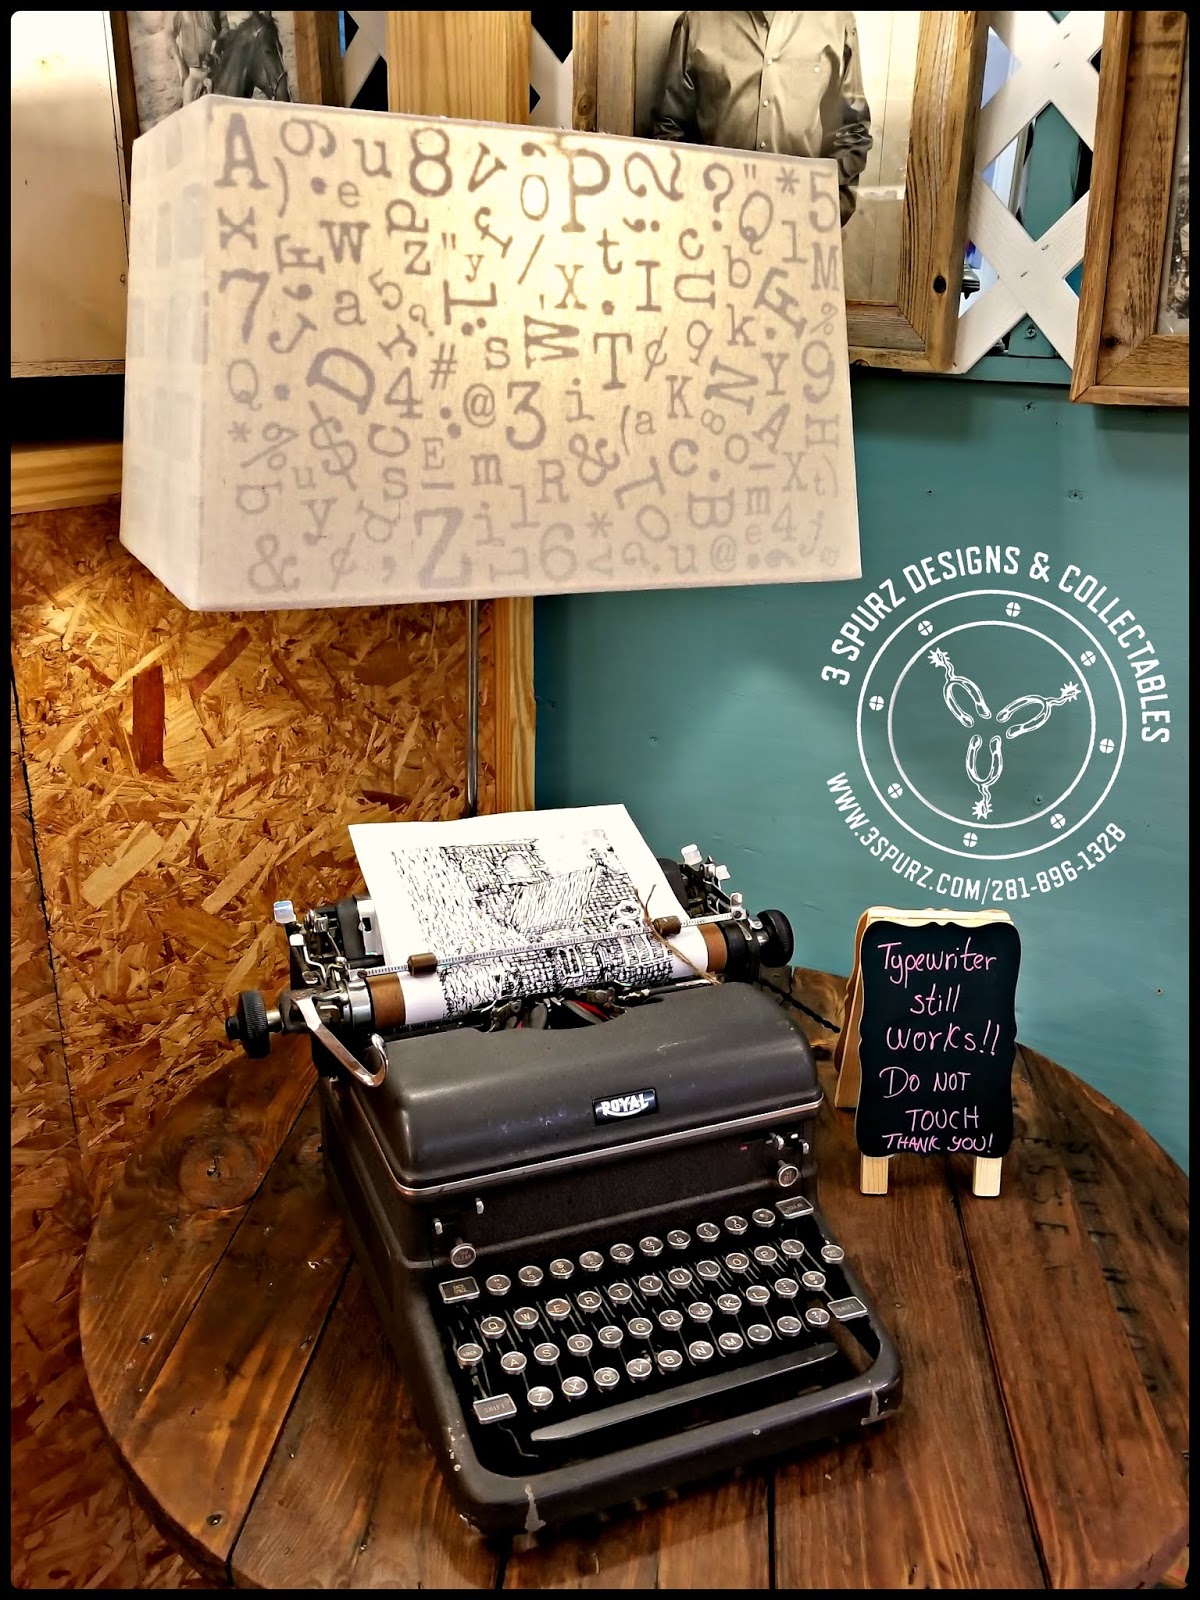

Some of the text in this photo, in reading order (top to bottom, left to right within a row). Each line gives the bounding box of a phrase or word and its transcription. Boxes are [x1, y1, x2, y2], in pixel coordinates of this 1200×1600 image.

[214, 112, 270, 191] A
[408, 126, 451, 199] 8
[337, 180, 361, 209] e
[560, 149, 611, 233] P
[809, 170, 837, 233] 5
[737, 189, 774, 256] Q
[596, 228, 623, 275] t
[722, 244, 752, 289] b
[810, 241, 839, 291] M
[218, 267, 272, 344] 7
[333, 288, 367, 327] a
[725, 303, 756, 347] k
[305, 346, 376, 415] D
[592, 331, 634, 391] T
[760, 351, 790, 396] Y
[802, 338, 836, 403] 9
[227, 358, 262, 411] Q
[384, 366, 423, 419] 4
[563, 377, 597, 423] i
[665, 374, 694, 420] K
[505, 379, 548, 450] 3
[634, 410, 656, 436] a
[752, 403, 790, 453] A
[422, 436, 445, 470] E
[470, 452, 504, 486] m
[536, 458, 570, 503] R
[473, 500, 505, 547] i
[772, 501, 797, 542] 4
[414, 507, 472, 588] Z
[540, 521, 578, 583] 6
[877, 936, 997, 989] Typewriter
[909, 983, 961, 1017] still
[601, 1093, 649, 1116] ROYAL
[933, 1071, 971, 1093] NOT
[905, 1105, 980, 1132] TOUCH
[881, 1132, 941, 1153] THANK
[674, 1273, 685, 1281] U
[584, 1297, 595, 1305] R
[665, 1315, 676, 1323] H
[488, 1321, 499, 1330] Q
[575, 1340, 585, 1348] D
[635, 1323, 646, 1331] G
[724, 1338, 737, 1346] M
[541, 1349, 552, 1358] S
[664, 1355, 675, 1364] B
[696, 1346, 707, 1355] N
[569, 1382, 579, 1392] X
